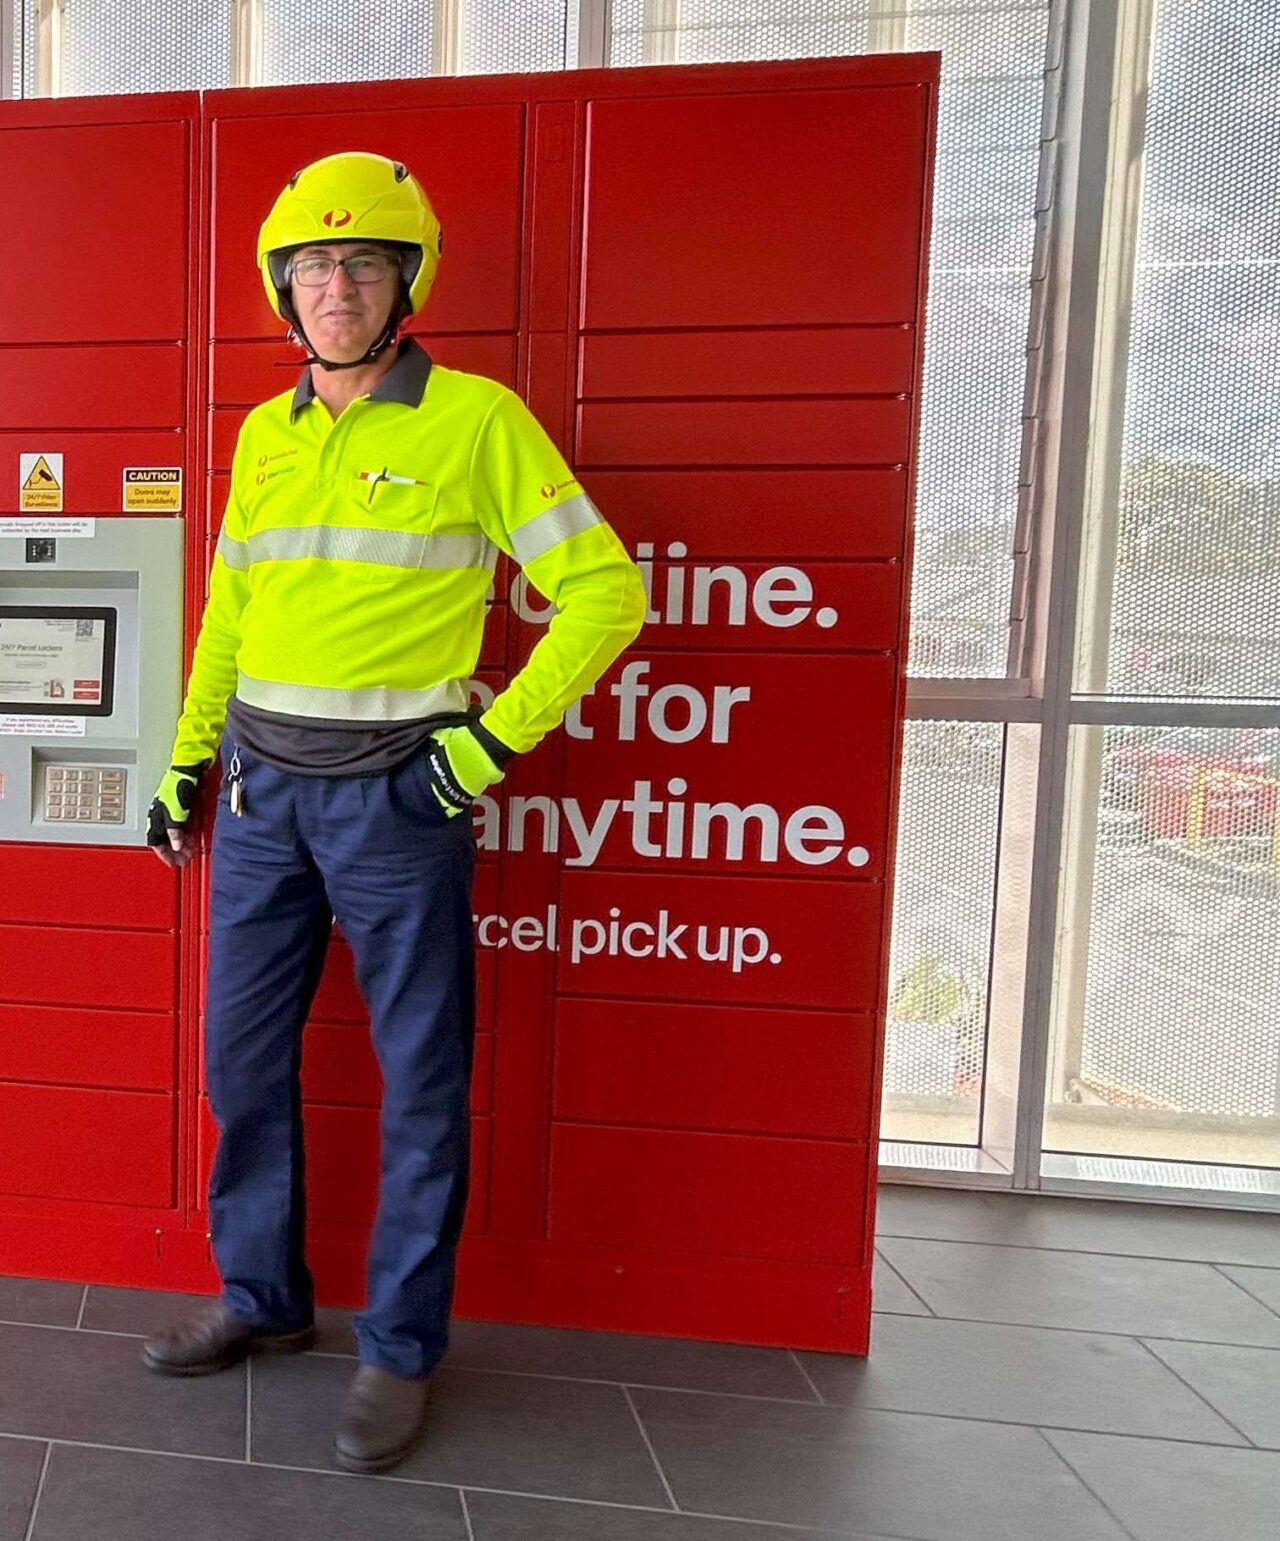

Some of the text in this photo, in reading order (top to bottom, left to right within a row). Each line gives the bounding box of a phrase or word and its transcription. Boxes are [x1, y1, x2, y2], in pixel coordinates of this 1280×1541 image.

[128, 471, 177, 481] CAUTION
[510, 541, 839, 629] oline.
[611, 660, 751, 744] for
[472, 777, 870, 868] anytime.
[570, 907, 688, 965] pick
[697, 925, 783, 973] up.
